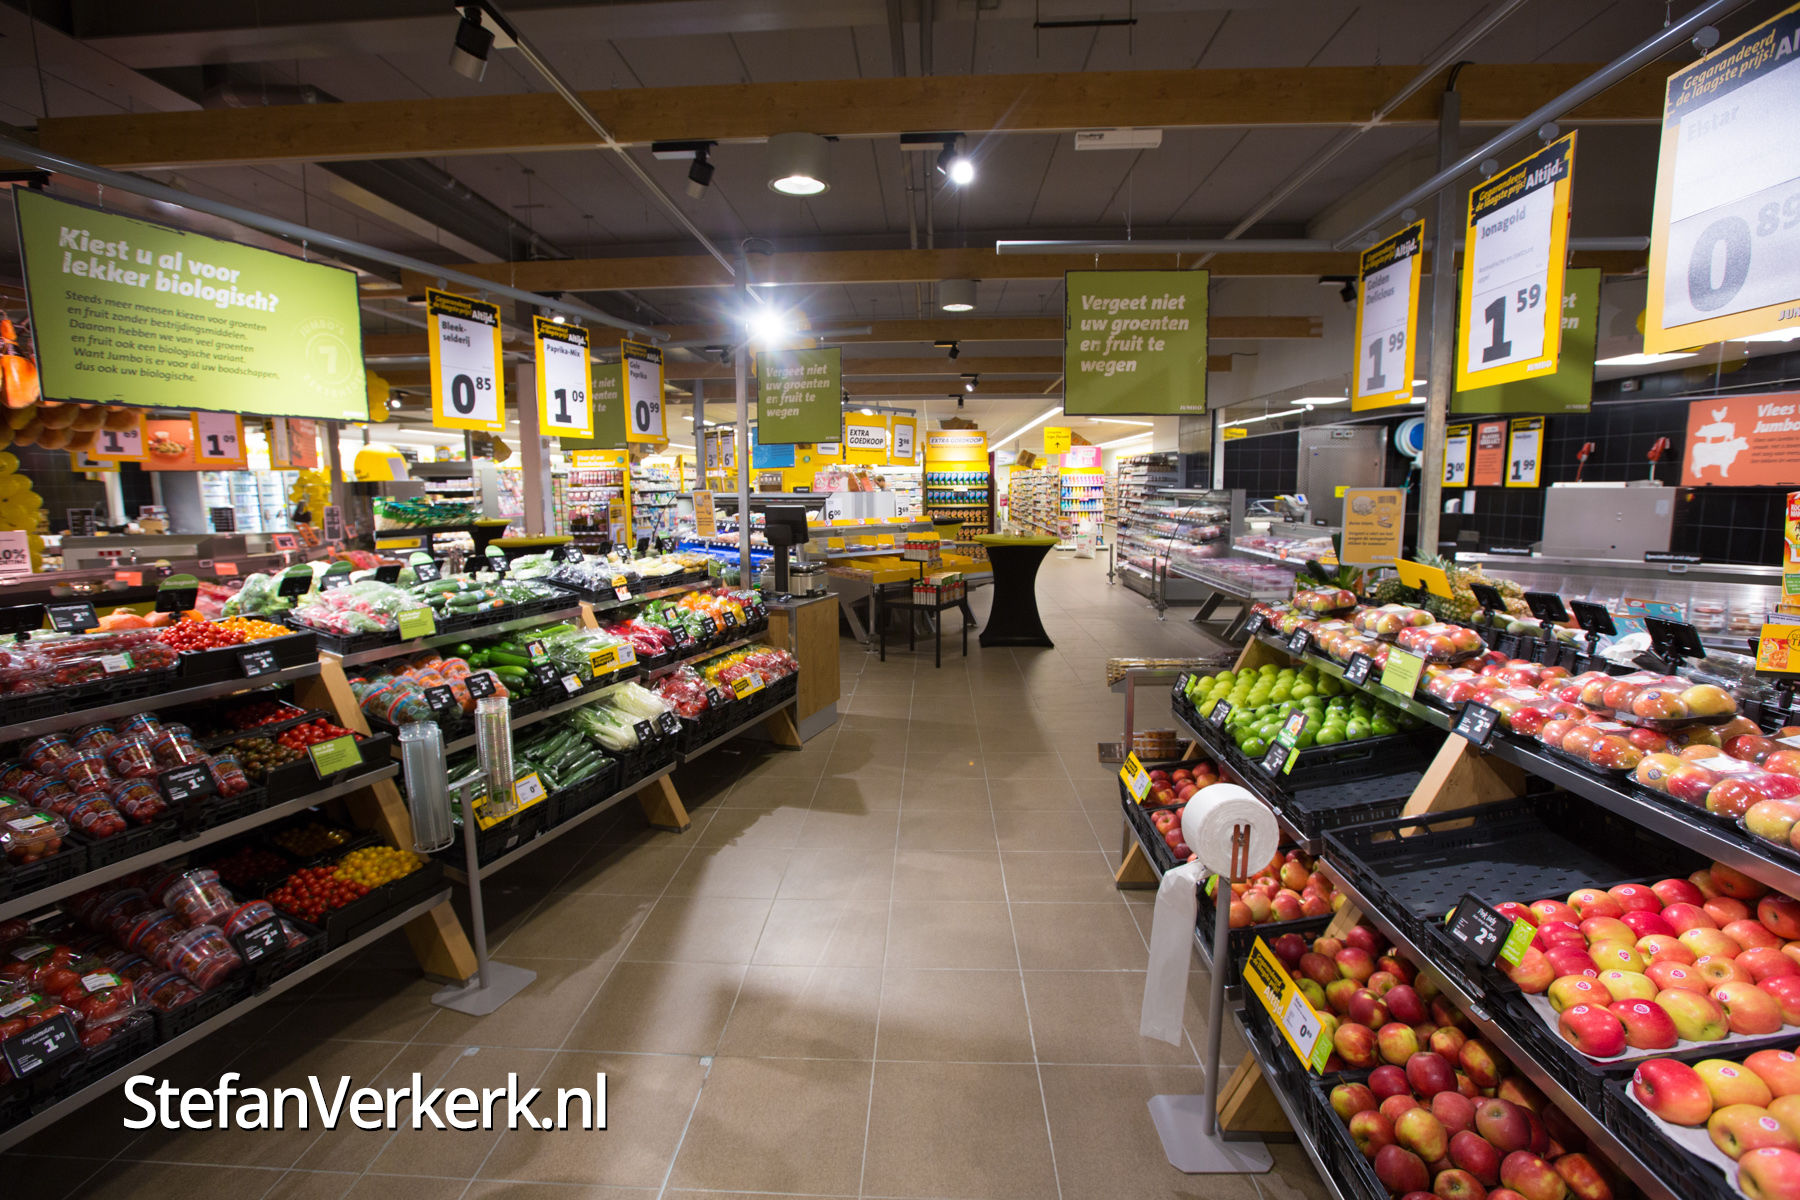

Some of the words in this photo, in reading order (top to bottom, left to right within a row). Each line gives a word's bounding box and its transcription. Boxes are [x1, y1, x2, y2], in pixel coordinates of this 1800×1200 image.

[1683, 28, 1776, 91] Gegarandeerd
[1676, 90, 1691, 107] de
[1692, 67, 1737, 99] laagste
[1738, 43, 1776, 79] prijs!
[1687, 106, 1740, 143] Elstar
[1479, 166, 1528, 201] Gegarandeerd
[1525, 158, 1563, 191] Altijd.
[1481, 205, 1526, 240] Jonagold
[58, 226, 130, 261] Kiest
[136, 249, 152, 265] u
[158, 251, 182, 271] al
[188, 260, 240, 284] voor
[62, 251, 150, 288] lekker
[155, 270, 279, 313] biologisch?
[1368, 274, 1390, 291] Golden
[1081, 294, 1147, 315] Vergeet
[1151, 293, 1186, 311] niet
[1366, 287, 1395, 306] Delicious
[65, 290, 102, 305] Steeds
[104, 298, 133, 309] meer
[134, 303, 174, 316] mensen
[176, 308, 206, 321] kiezen
[207, 316, 228, 325] voor
[228, 320, 267, 331] groenten
[67, 306, 82, 316] en
[83, 306, 109, 319] fruit
[112, 313, 148, 325] zonder
[472, 309, 495, 325] Altijd.
[69, 318, 116, 333] Daarom
[118, 325, 157, 339] hebben
[159, 333, 174, 342] we
[176, 335, 194, 343] van
[195, 338, 214, 348] veel
[215, 341, 255, 353] groenten
[442, 320, 467, 333] Bleek-
[1080, 318, 1108, 332] uw
[1110, 315, 1189, 337] groenten
[71, 334, 86, 343] en
[87, 334, 112, 347] fruit
[114, 340, 136, 350] ook
[137, 343, 157, 352] een
[158, 344, 212, 359] biologische
[443, 333, 470, 347] selderij
[1080, 338, 1100, 352] en
[1103, 335, 1143, 356] fruit
[1147, 336, 1166, 352] te
[73, 346, 105, 359] Want
[107, 351, 144, 364] Jumbo
[155, 358, 165, 366] er
[167, 360, 188, 369] voor
[201, 363, 216, 372] uw
[546, 343, 580, 357] Paprika-Mix
[74, 360, 96, 372] dus
[97, 364, 118, 375] ook
[120, 368, 138, 376] uw
[766, 365, 805, 380] Vergeet
[807, 364, 827, 376] niet
[1080, 359, 1137, 377] wegen
[766, 382, 783, 391] uw
[783, 378, 831, 393] groenten
[766, 395, 778, 404] en
[779, 392, 803, 406] fruit
[805, 392, 816, 402] te
[766, 408, 800, 420] wegen
[1757, 402, 1796, 418] Vlees
[850, 429, 870, 437] EXTRA
[1752, 417, 1800, 434] Jumbo
[850, 437, 884, 446] GOEDKOOP
[0, 549, 26, 560] 0%
[1263, 985, 1283, 1020] Altijd.
